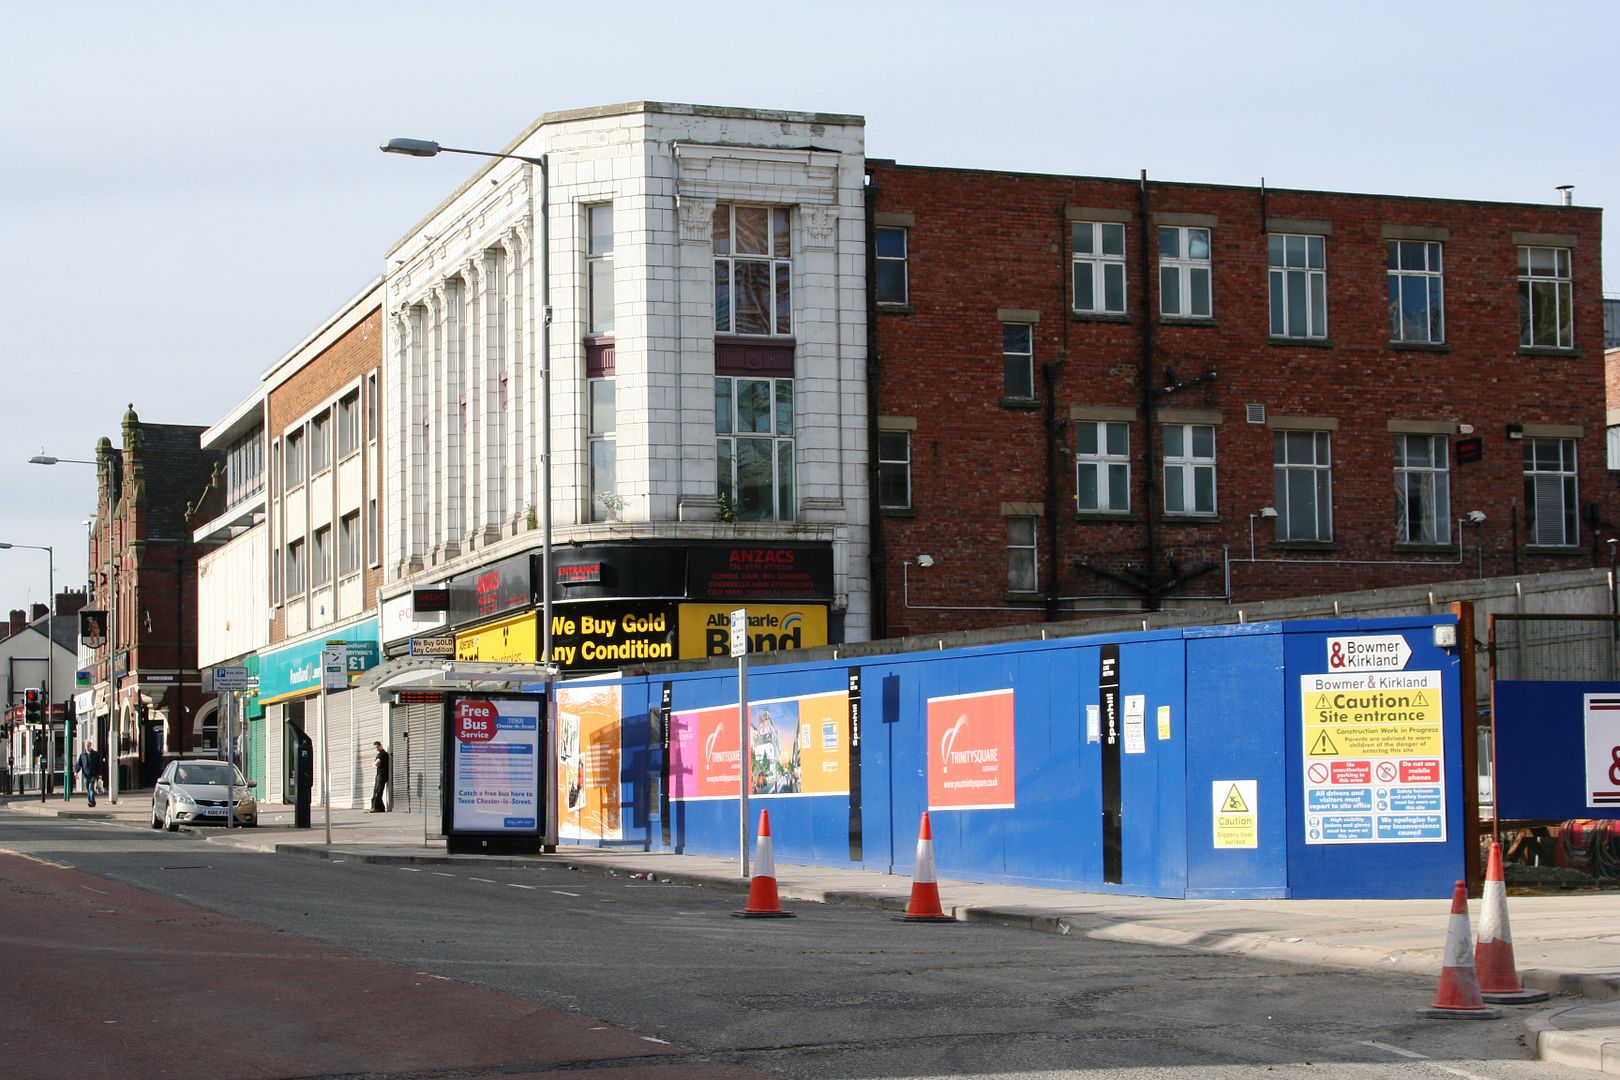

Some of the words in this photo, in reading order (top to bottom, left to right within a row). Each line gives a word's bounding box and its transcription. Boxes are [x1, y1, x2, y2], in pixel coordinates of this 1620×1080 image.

[729, 549, 794, 562] ANZACS
[558, 565, 599, 576] ENTRANCE
[552, 616, 576, 636] We
[582, 616, 616, 638] Buy
[622, 612, 666, 633] Gold
[706, 614, 778, 627] Albarle
[582, 639, 672, 660] Condition
[1330, 642, 1346, 668] &
[1348, 642, 1400, 654] Bowmer
[349, 656, 365, 670] £1
[1348, 654, 1398, 667] Kirkland
[1316, 679, 1364, 690] Bowmer
[1368, 675, 1376, 688] &
[1380, 676, 1428, 688] Kirkland
[1334, 693, 1410, 709] Caution
[461, 705, 489, 716] Free
[1320, 711, 1348, 723] Site
[1354, 711, 1424, 721] entrance
[463, 718, 487, 730] Bus
[1106, 693, 1116, 744] Spenhill
[1219, 817, 1252, 825] Caution
